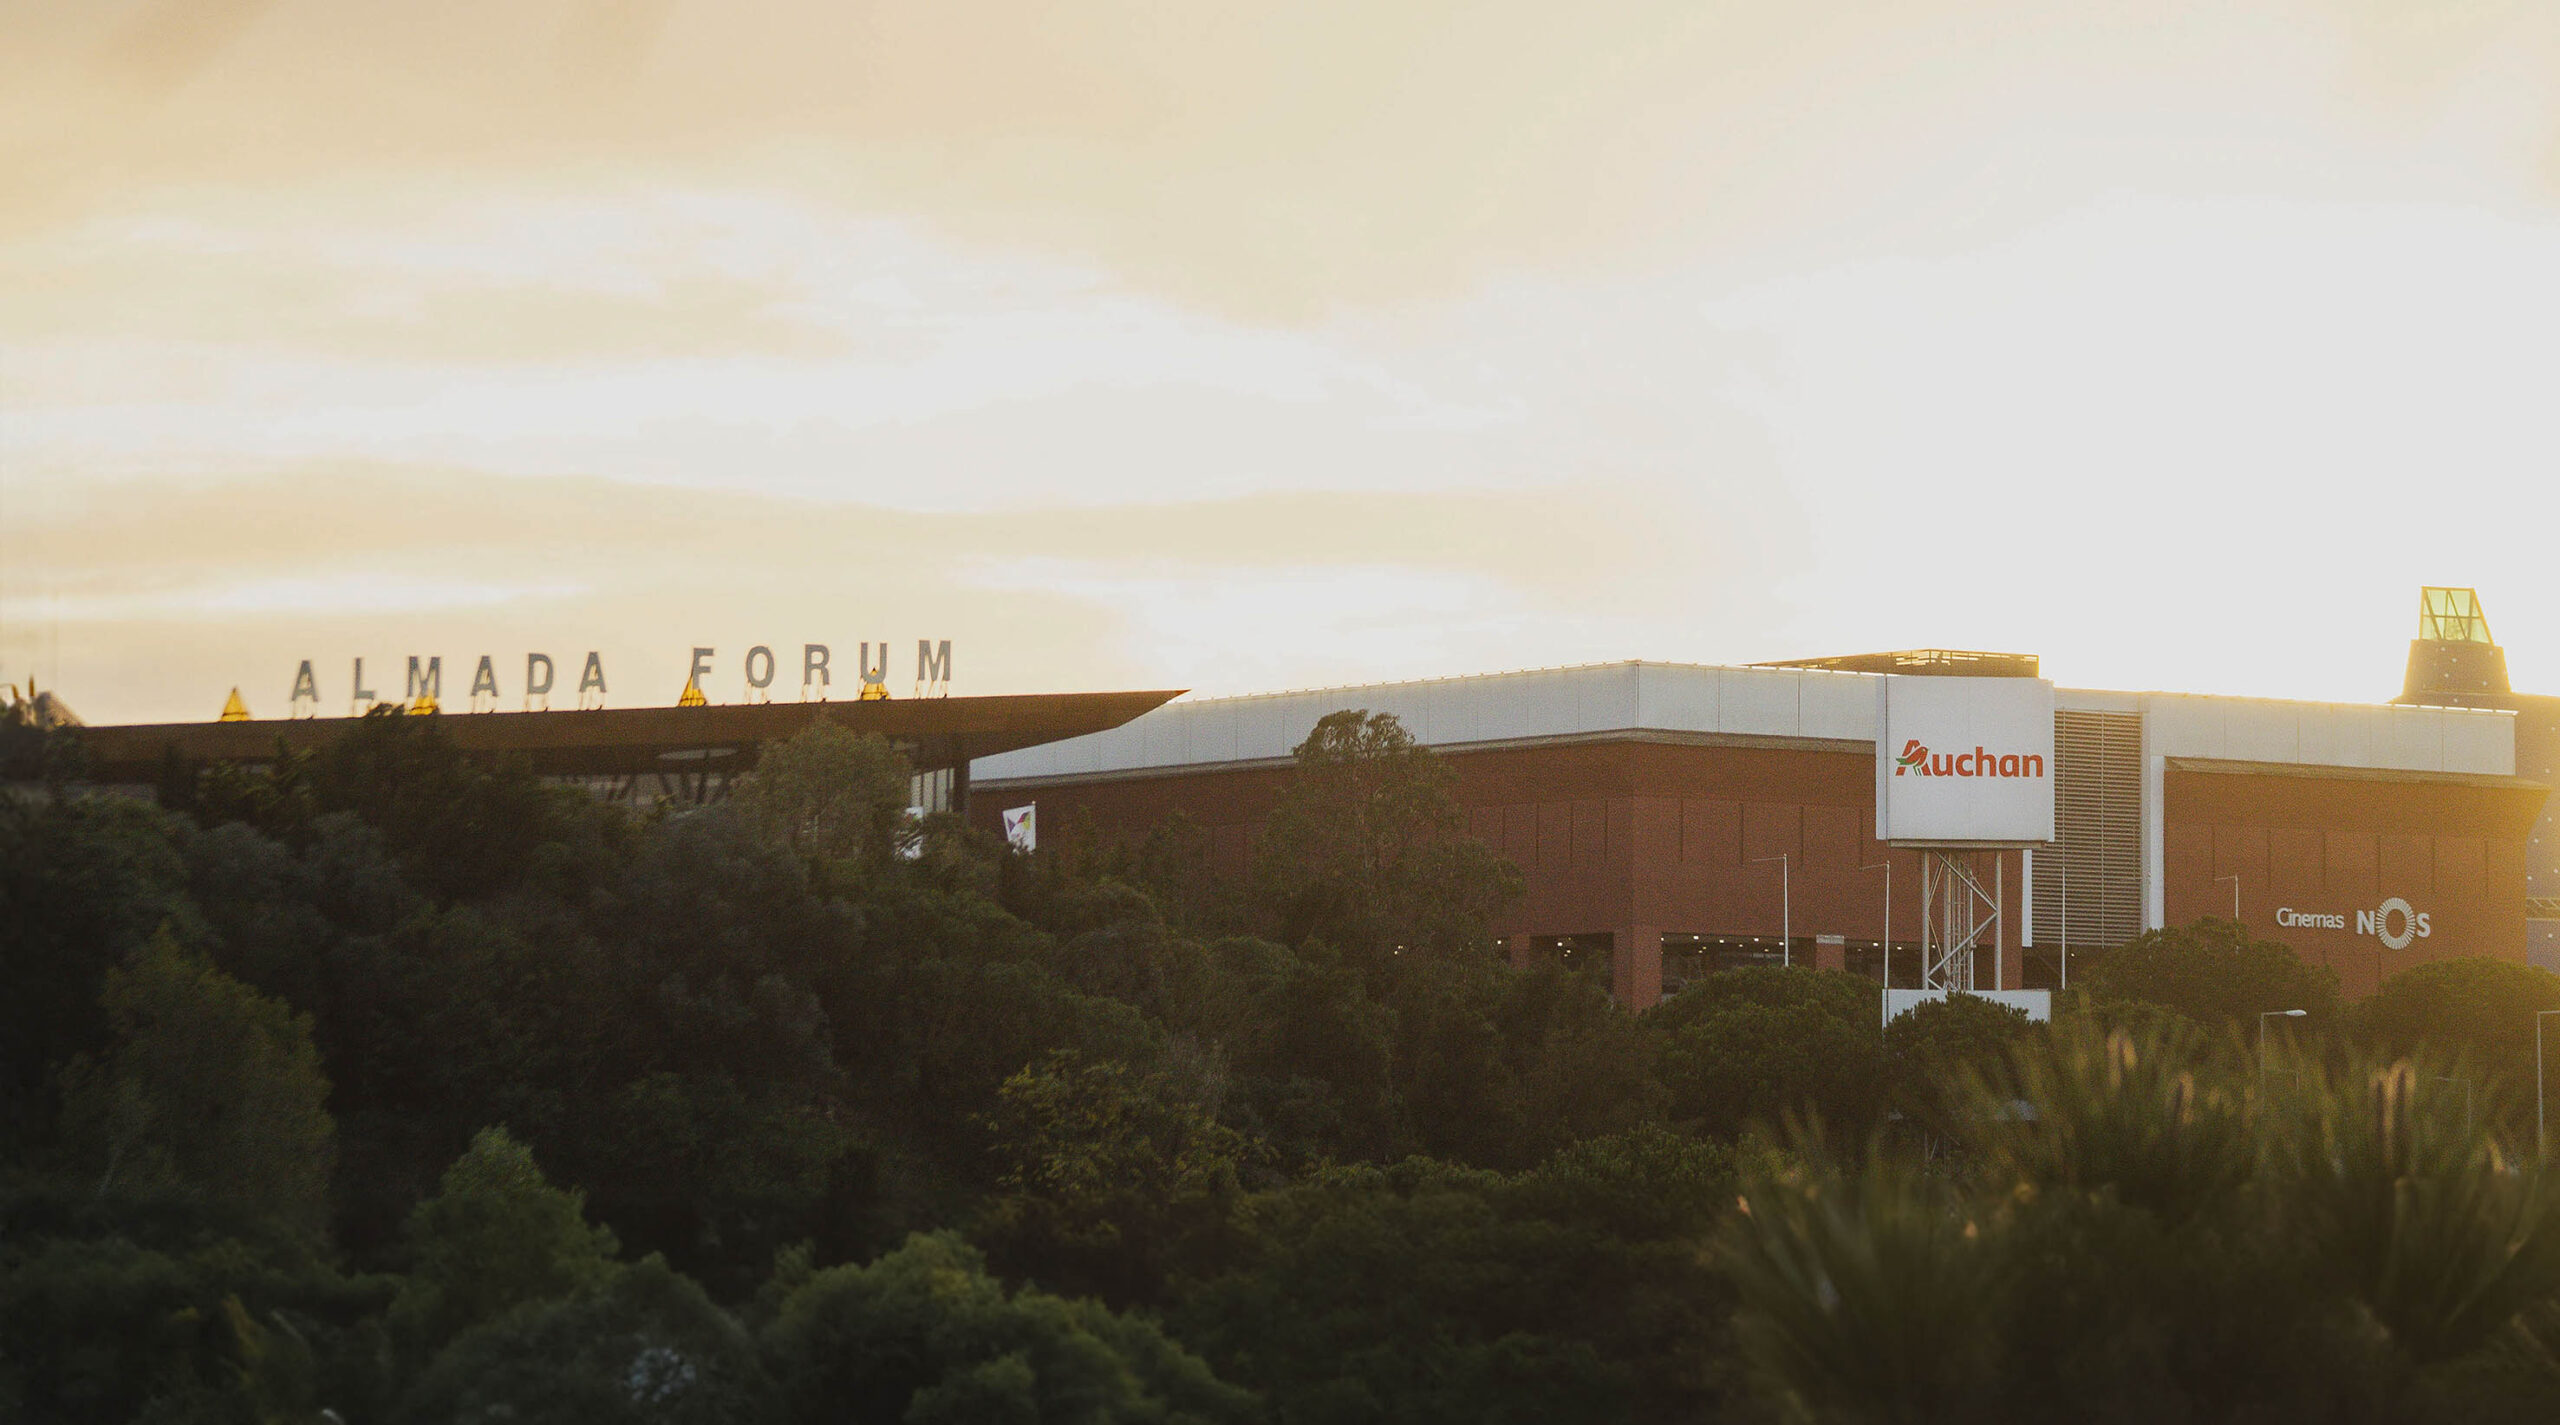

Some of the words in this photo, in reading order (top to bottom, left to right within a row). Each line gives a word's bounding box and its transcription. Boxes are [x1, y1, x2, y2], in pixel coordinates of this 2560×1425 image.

[291, 651, 607, 701] ALMADA
[692, 639, 951, 690] FORUM
[1895, 739, 2044, 777] Auchan
[2276, 907, 2345, 929] Cinemas
[2356, 897, 2431, 950] NOS
